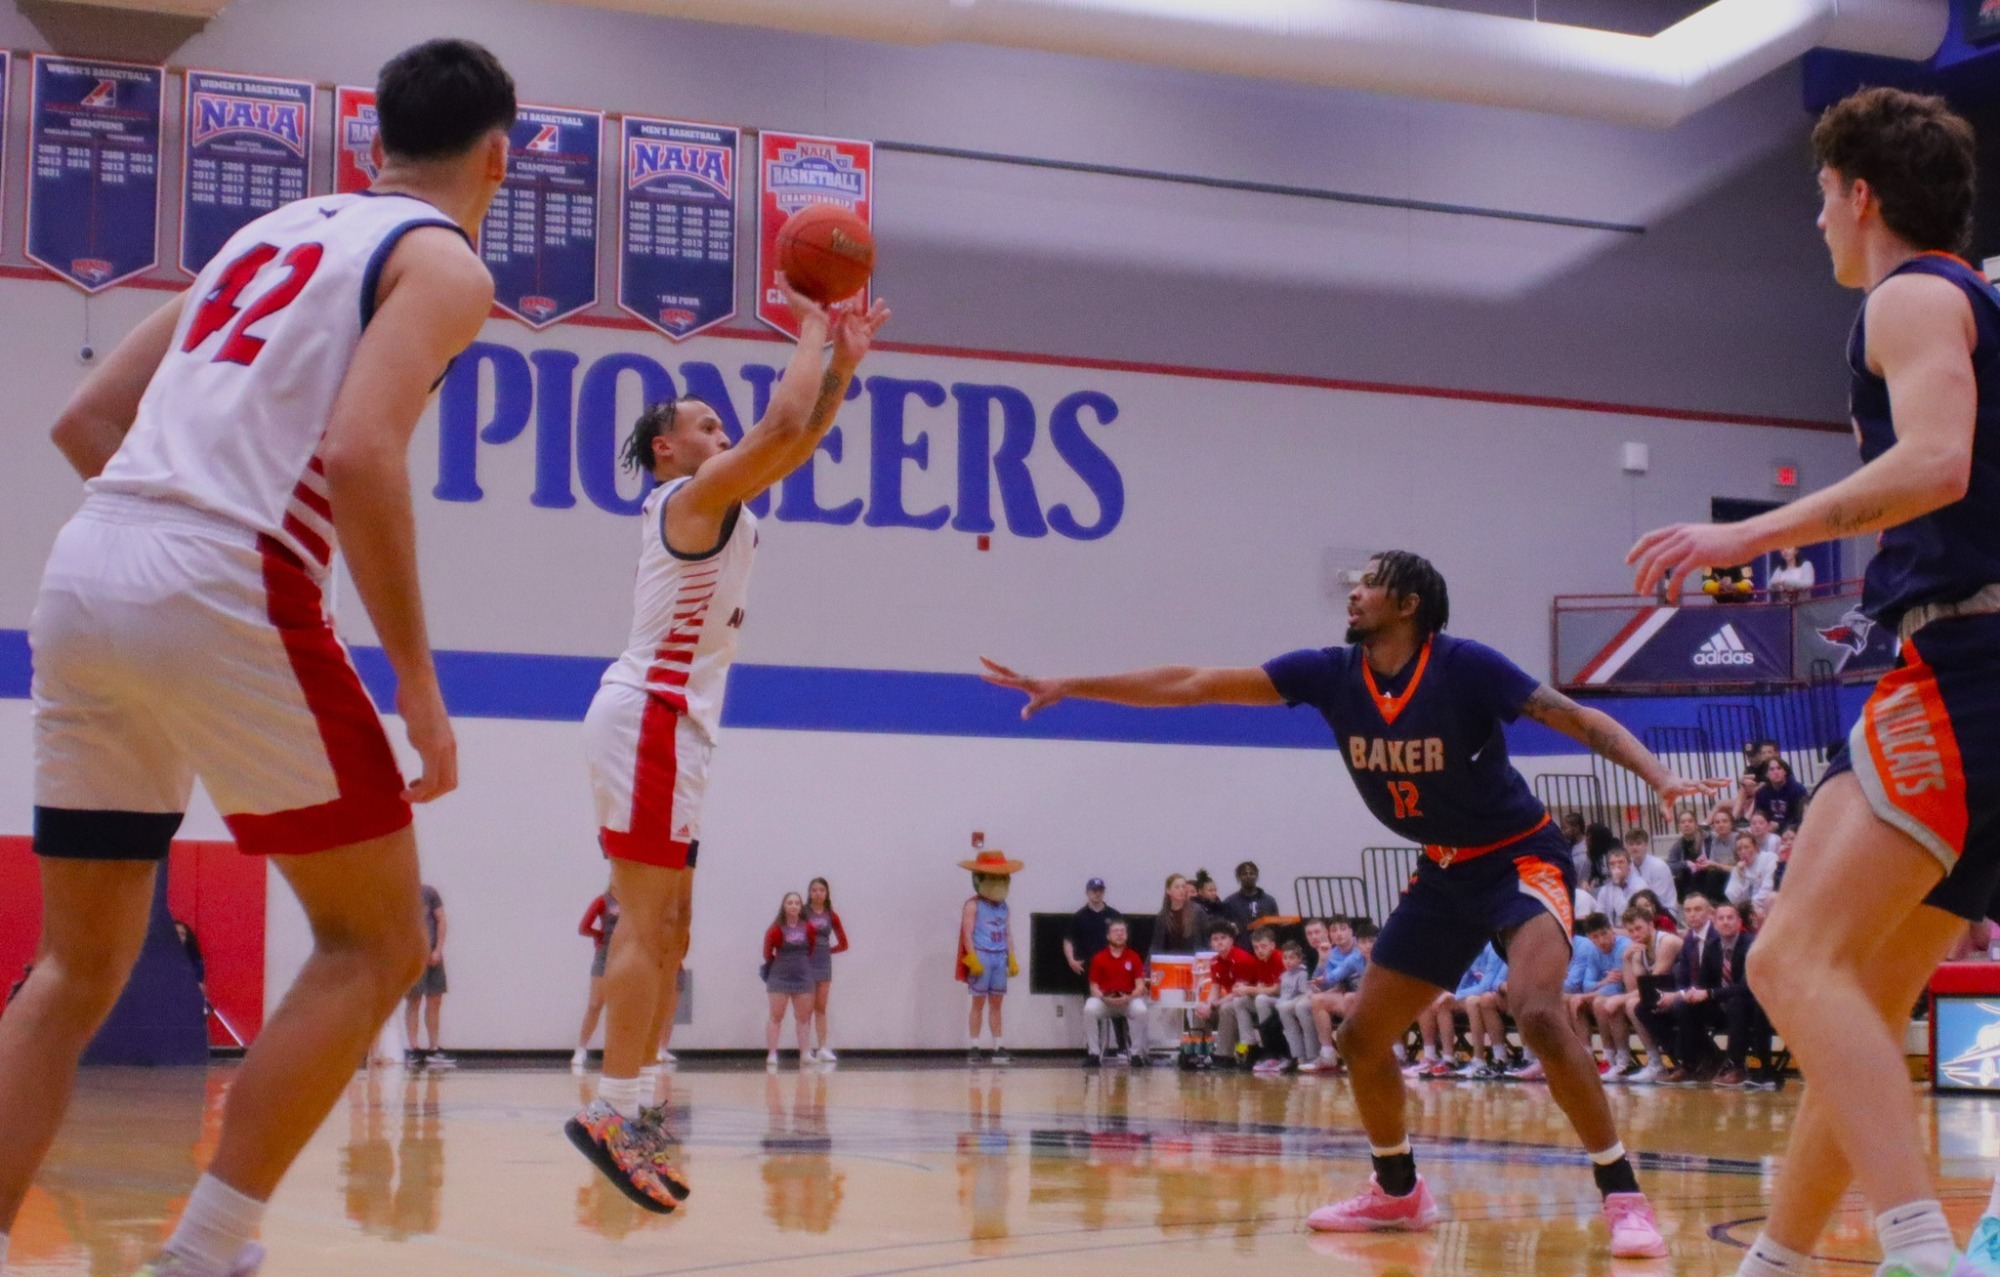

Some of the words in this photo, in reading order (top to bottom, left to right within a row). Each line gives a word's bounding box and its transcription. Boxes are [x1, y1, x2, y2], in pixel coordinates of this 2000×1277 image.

[200, 79, 243, 91] WOMEN'S
[244, 83, 301, 97] BASKETBALL
[198, 98, 302, 147] NAIA
[529, 111, 583, 126] BASKETBALL
[641, 125, 667, 136] MEN'S
[669, 128, 721, 141] BASKETBALL
[800, 146, 833, 161] NAIA
[516, 161, 566, 175] CHAMPIONS
[633, 143, 727, 187] NAIA
[772, 166, 859, 191] BASKETBALL
[781, 194, 850, 206] CHAMPIONSHIP
[180, 241, 324, 367] 42
[432, 341, 1125, 541] PIONEERS
[1693, 649, 1755, 665] adidas
[1349, 736, 1445, 774] BAKER
[1387, 780, 1424, 818] 12
